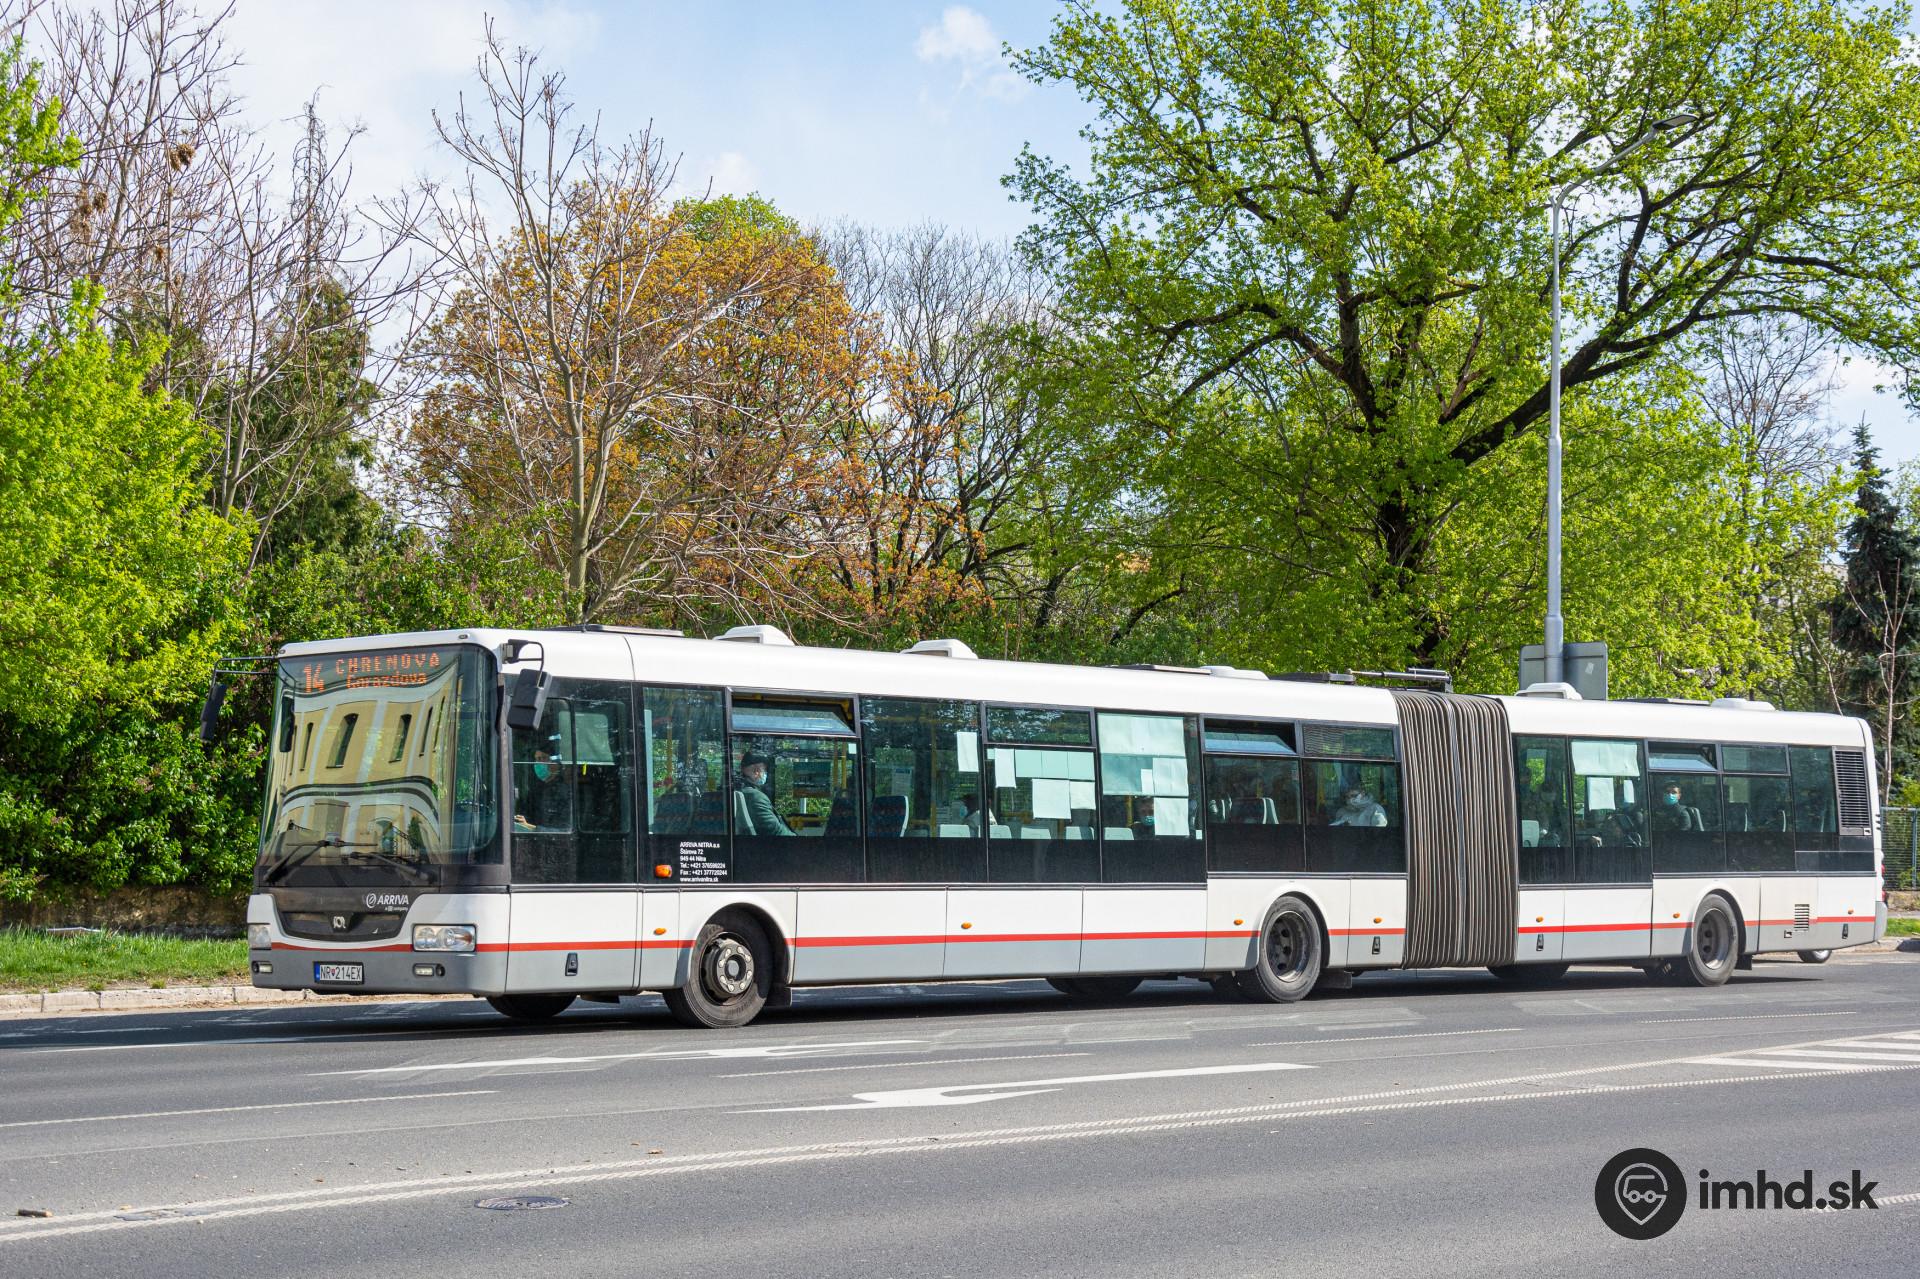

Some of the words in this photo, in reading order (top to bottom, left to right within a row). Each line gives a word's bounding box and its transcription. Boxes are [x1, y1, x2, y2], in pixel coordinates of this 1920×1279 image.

[303, 663, 325, 693] 14
[335, 652, 440, 675] CHRENOVA
[377, 894, 409, 905] ARRIVA
